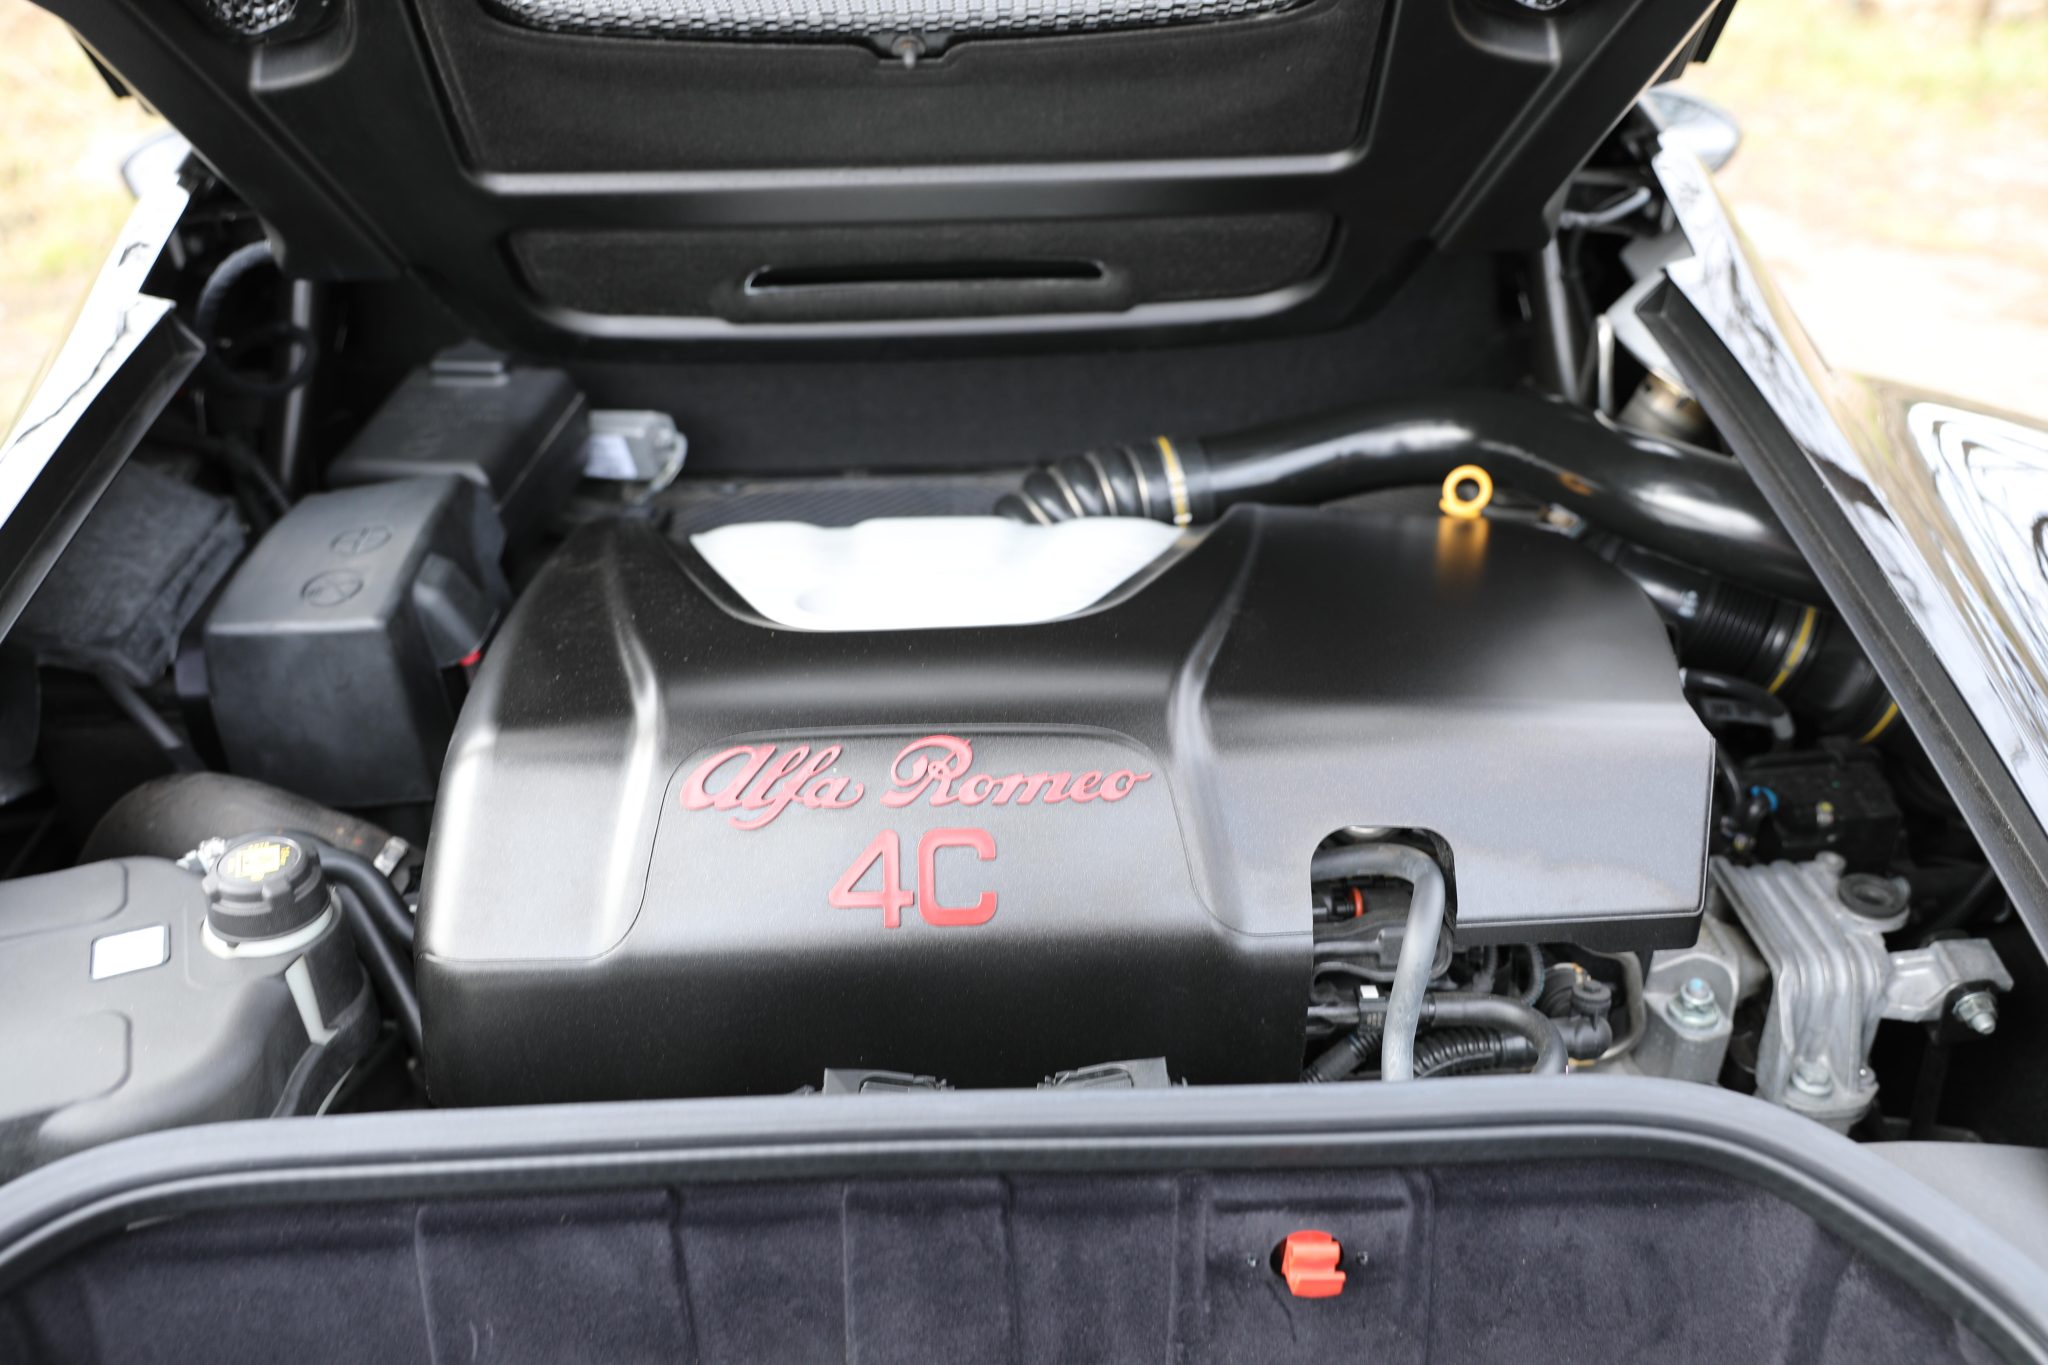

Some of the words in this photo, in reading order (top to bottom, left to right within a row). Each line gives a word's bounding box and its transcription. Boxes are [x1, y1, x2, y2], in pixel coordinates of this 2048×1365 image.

[680, 744, 866, 830] Alfa
[880, 734, 1152, 808] Romeo
[828, 828, 998, 928] 4C
